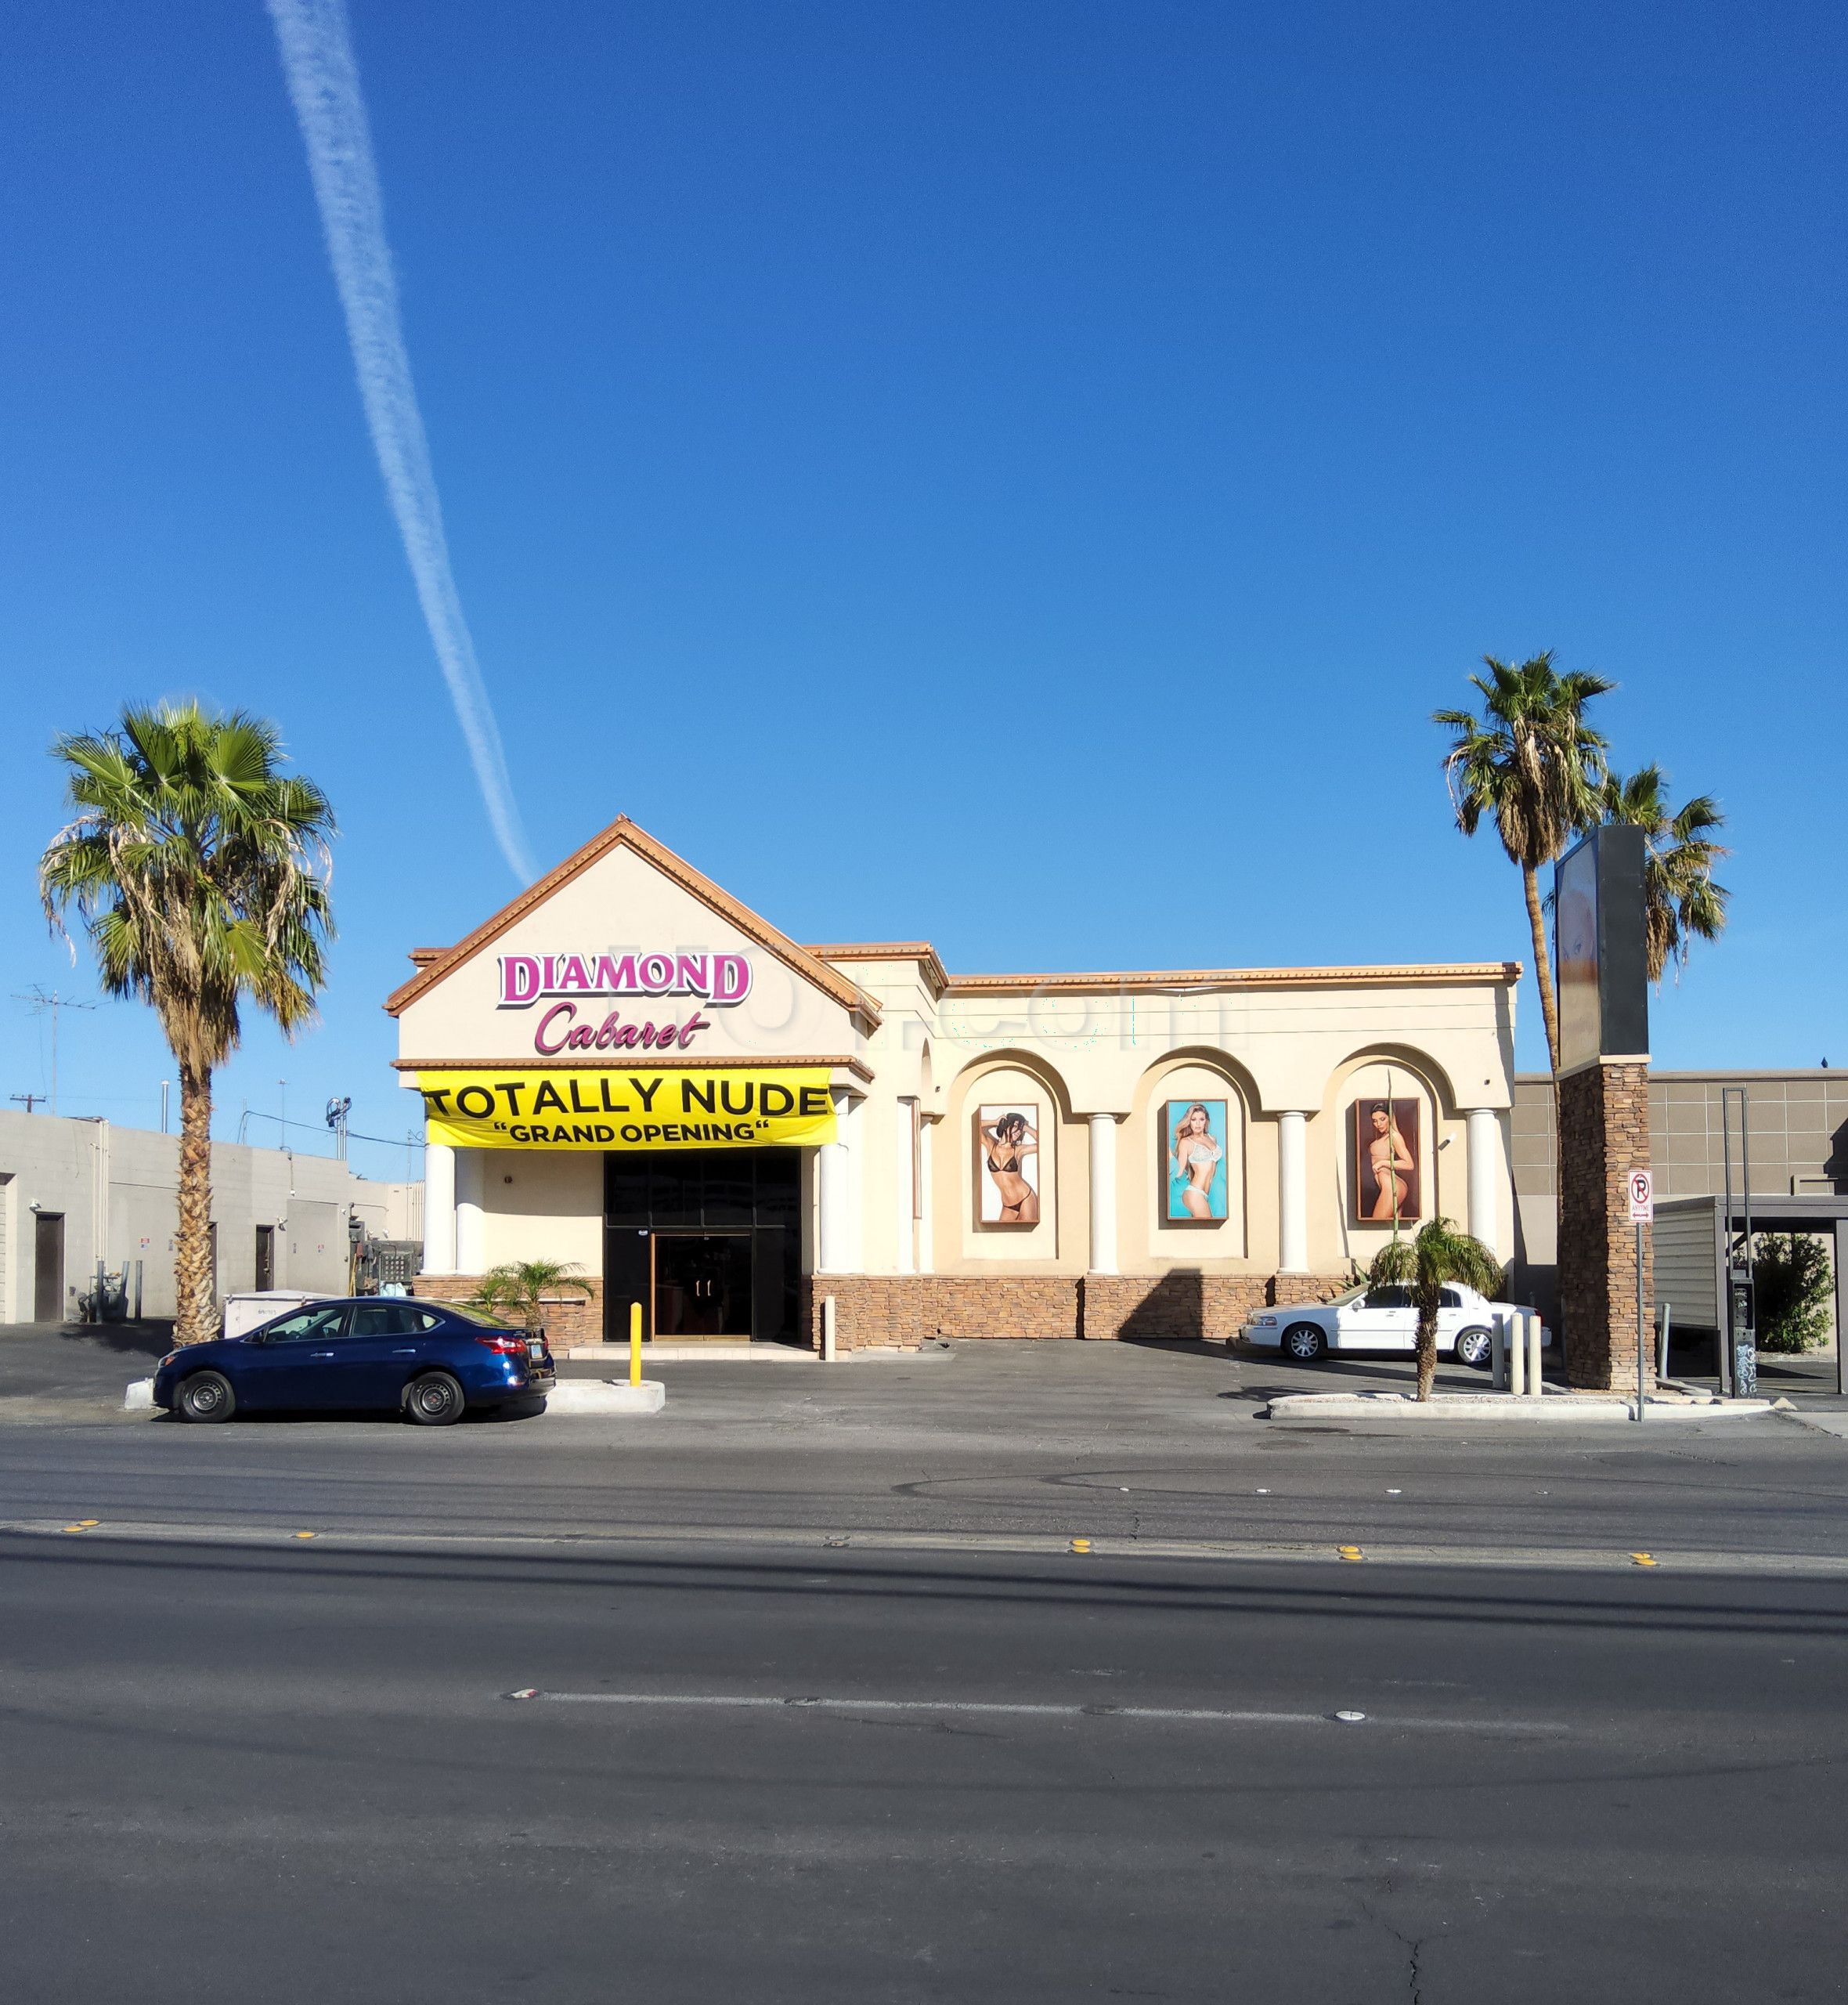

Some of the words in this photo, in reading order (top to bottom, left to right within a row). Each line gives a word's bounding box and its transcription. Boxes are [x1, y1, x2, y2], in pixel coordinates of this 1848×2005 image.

[499, 952, 753, 1007] DIAMOND
[535, 1002, 710, 1055] Cabaret
[422, 1078, 664, 1118] TOTALLY
[681, 1078, 828, 1116] NUDE
